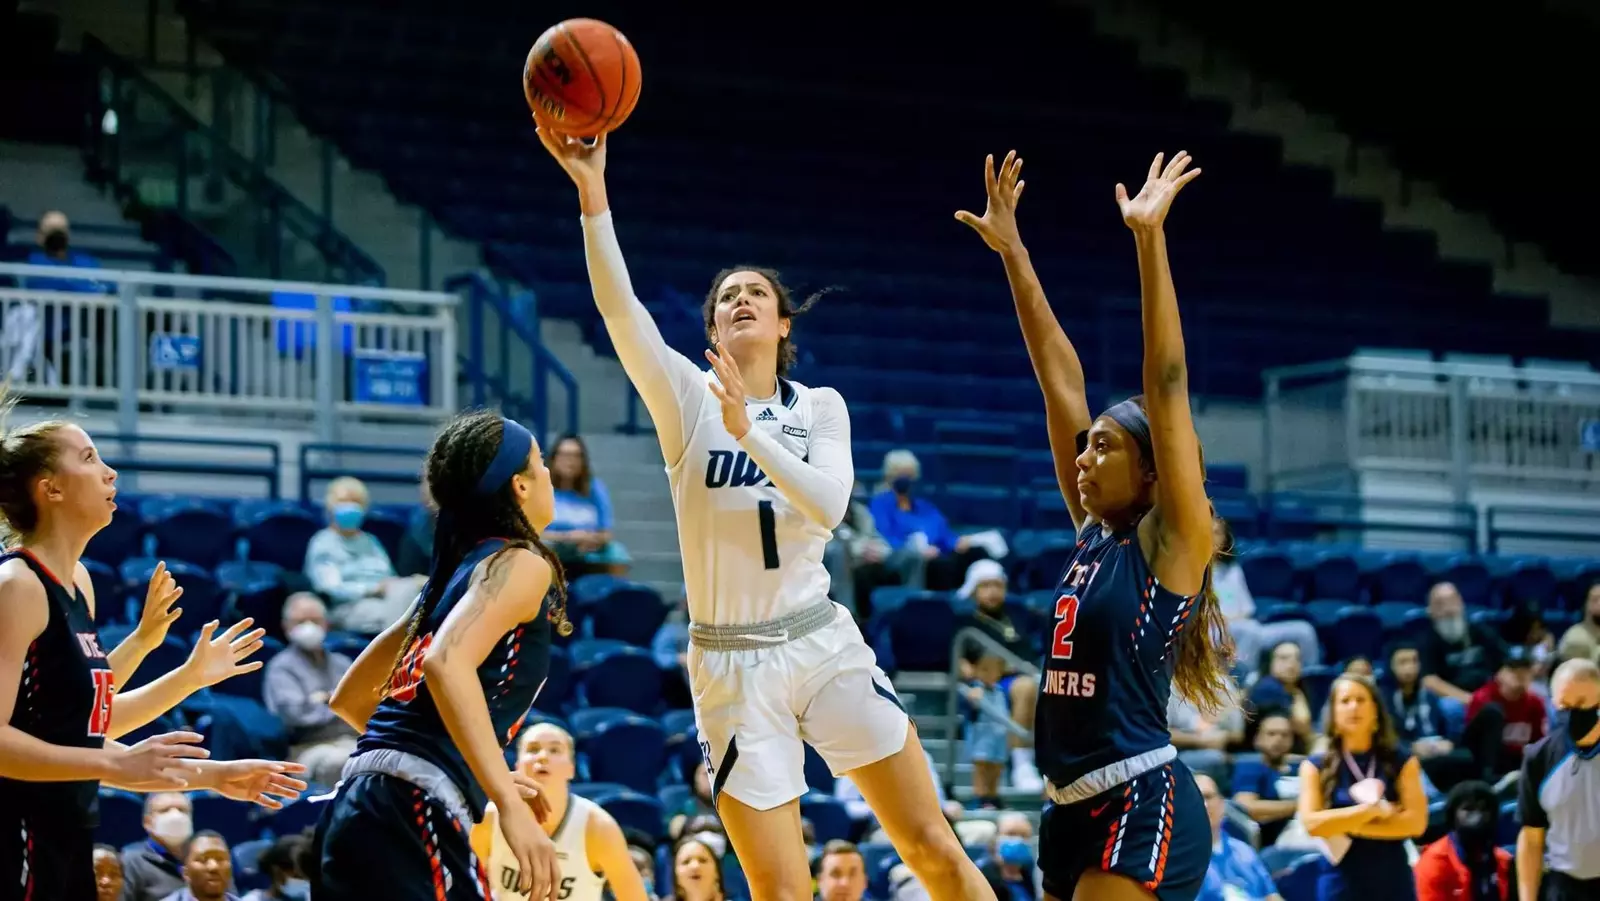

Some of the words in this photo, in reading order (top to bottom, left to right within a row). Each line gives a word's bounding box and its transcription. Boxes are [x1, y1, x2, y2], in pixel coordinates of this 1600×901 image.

[705, 450, 790, 488] OW
[758, 501, 780, 570] 1
[1052, 594, 1079, 659] 2
[87, 668, 115, 738] 15
[501, 865, 576, 900] OS
